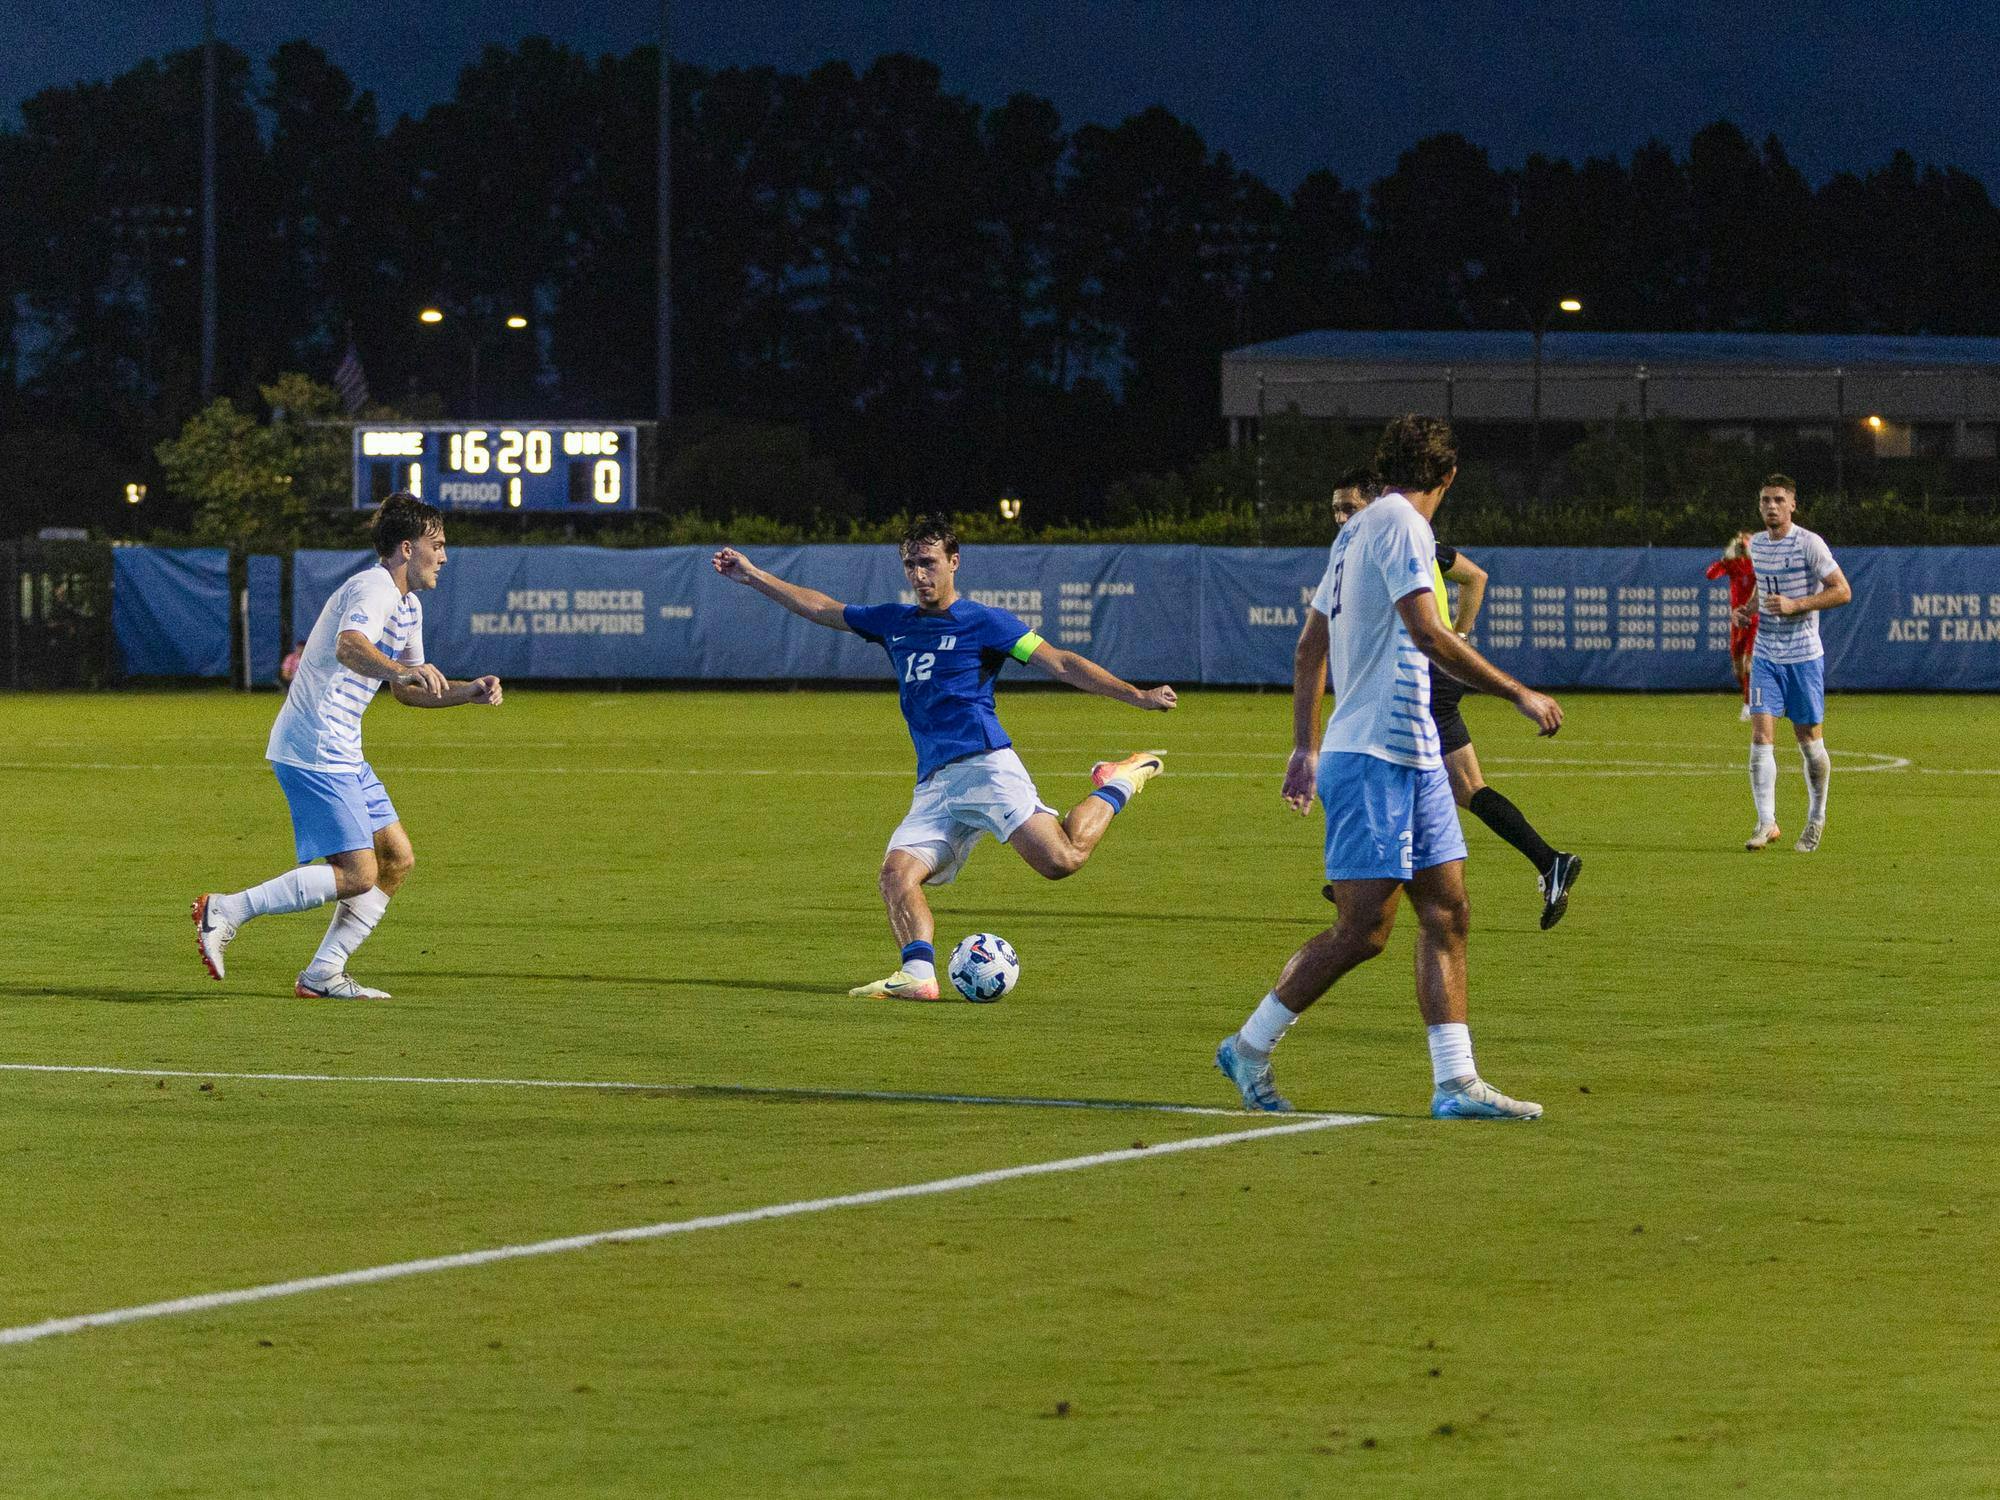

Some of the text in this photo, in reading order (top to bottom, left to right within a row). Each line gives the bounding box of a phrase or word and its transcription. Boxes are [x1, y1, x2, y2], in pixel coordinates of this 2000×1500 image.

[409, 462, 422, 498] 1
[593, 459, 621, 504] 0
[439, 477, 522, 507] PERIOD 1
[1662, 587, 1700, 601] 2007
[1765, 576, 1780, 595] 11
[508, 590, 644, 611] MEN'S SOCCER
[968, 590, 1042, 611] SOCCER
[1618, 604, 1655, 617] 2004
[1912, 594, 1981, 616] MEN'S
[470, 613, 644, 634] NCAA CHAMPIONS
[1249, 607, 1298, 625] NCAA
[1662, 620, 1700, 633] 2009
[1887, 619, 1929, 641] ACC
[1488, 636, 1522, 649] 1987
[1574, 636, 1612, 649] 2000
[1662, 636, 1696, 650] 2010
[905, 652, 936, 683] 12
